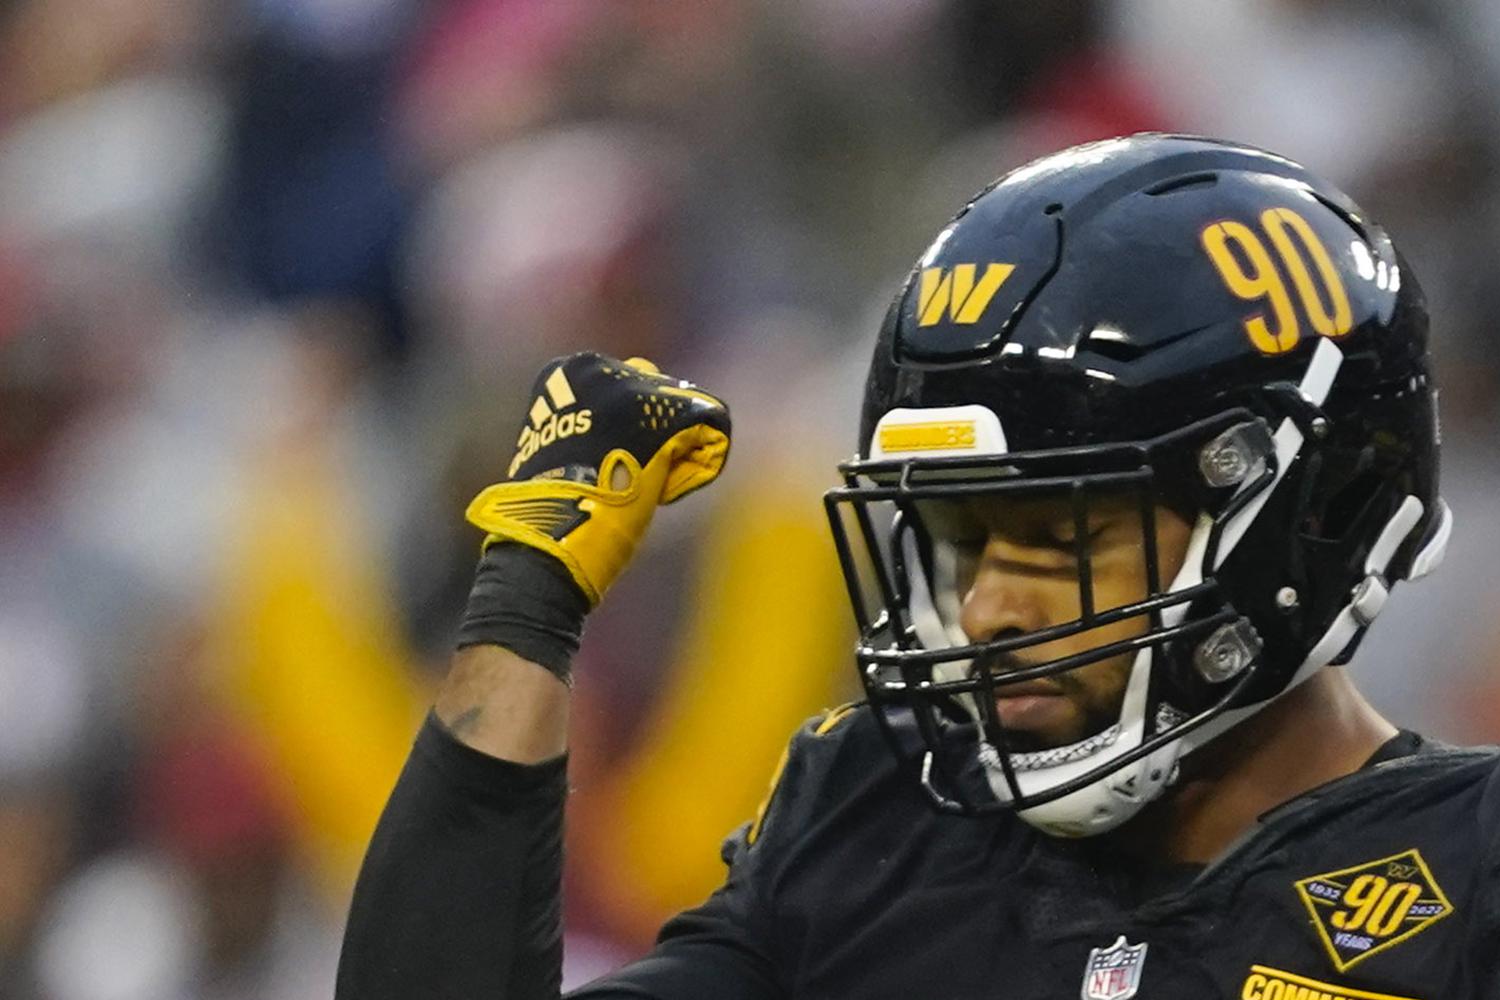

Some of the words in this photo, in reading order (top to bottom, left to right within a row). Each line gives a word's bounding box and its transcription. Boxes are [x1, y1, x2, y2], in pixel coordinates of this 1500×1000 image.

[917, 262, 1016, 327] W
[1203, 207, 1353, 355] 90
[508, 408, 593, 479] adidas
[1308, 882, 1342, 900] 1932
[1330, 873, 1423, 937] 90
[1333, 931, 1375, 951] YEARS
[1091, 967, 1131, 998] NFL
